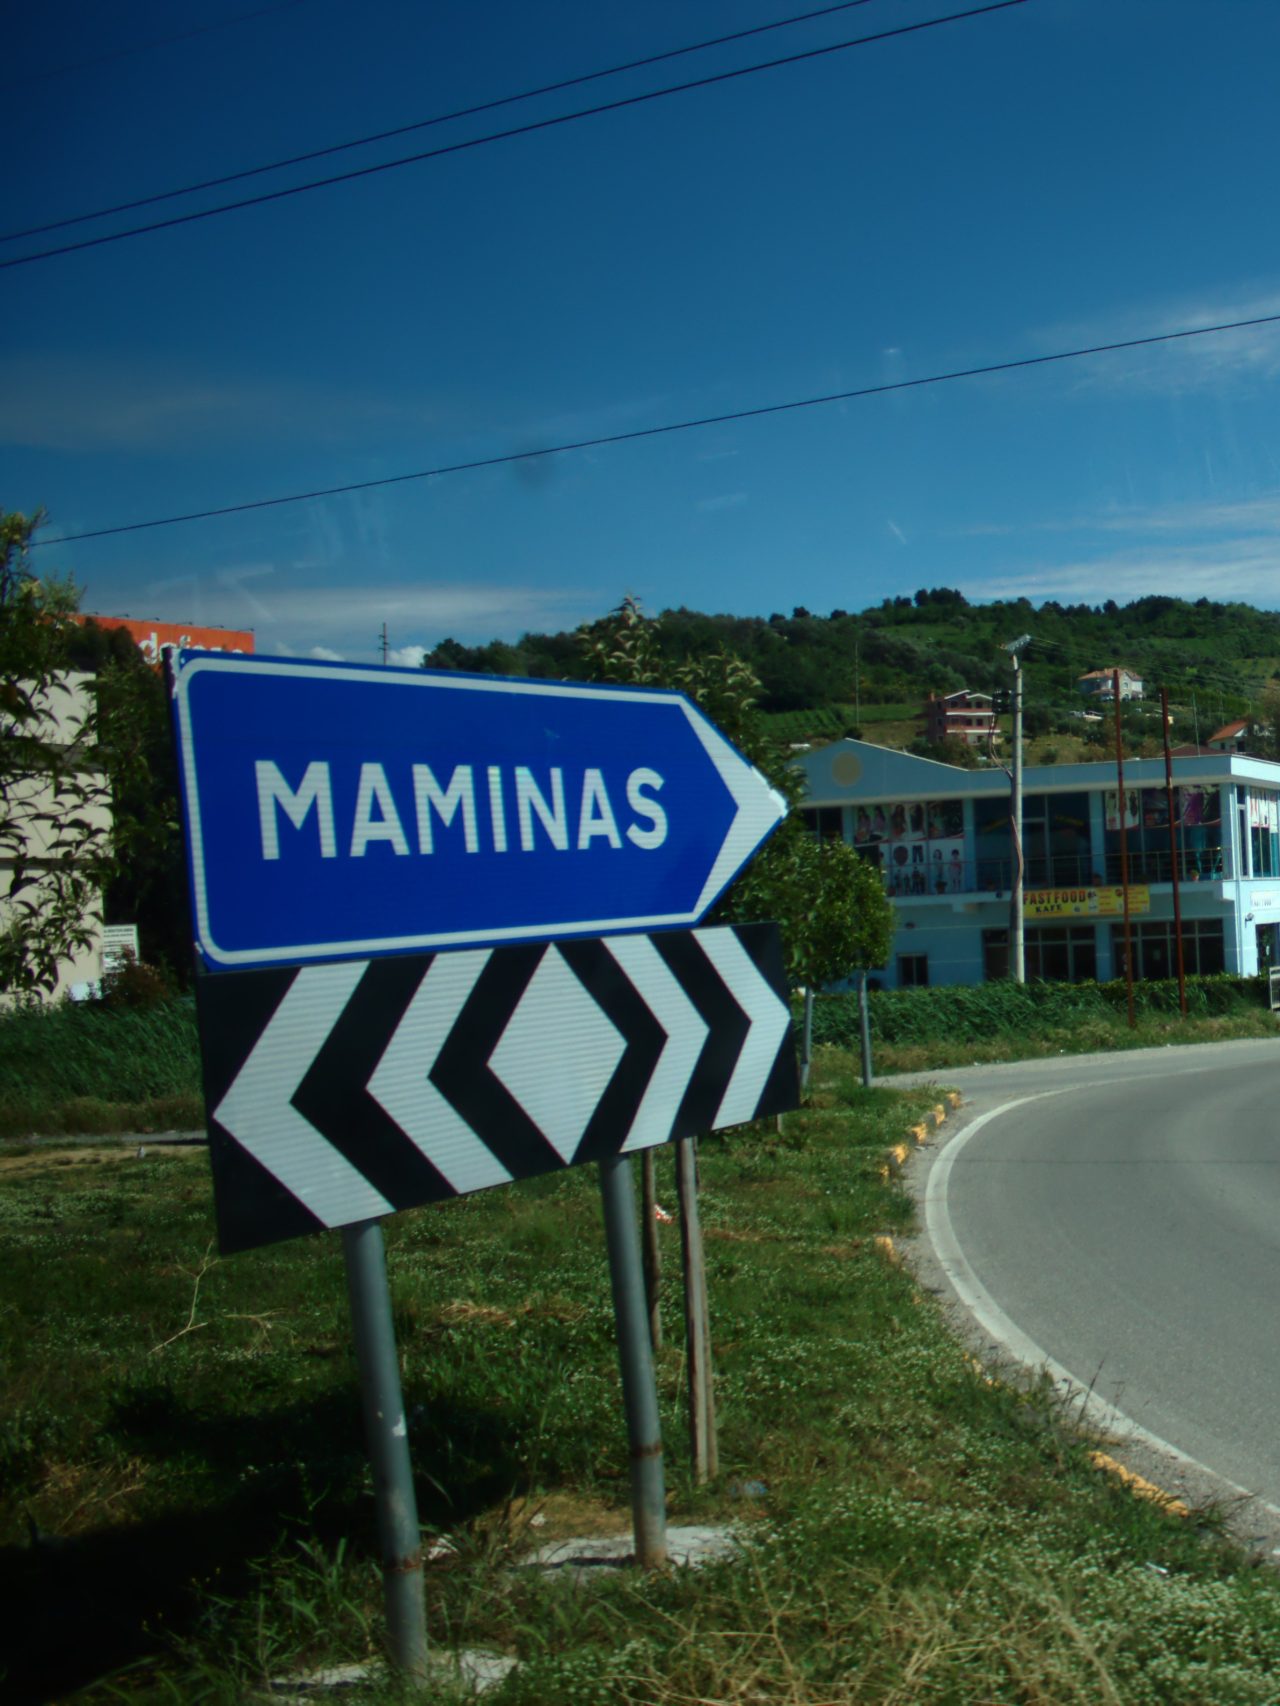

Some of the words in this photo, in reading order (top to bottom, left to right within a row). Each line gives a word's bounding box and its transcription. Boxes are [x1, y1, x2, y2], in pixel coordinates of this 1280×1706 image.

[254, 760, 668, 860] MAMINAS
[1023, 892, 1051, 905] FAST
[1054, 890, 1086, 904] FOOD
